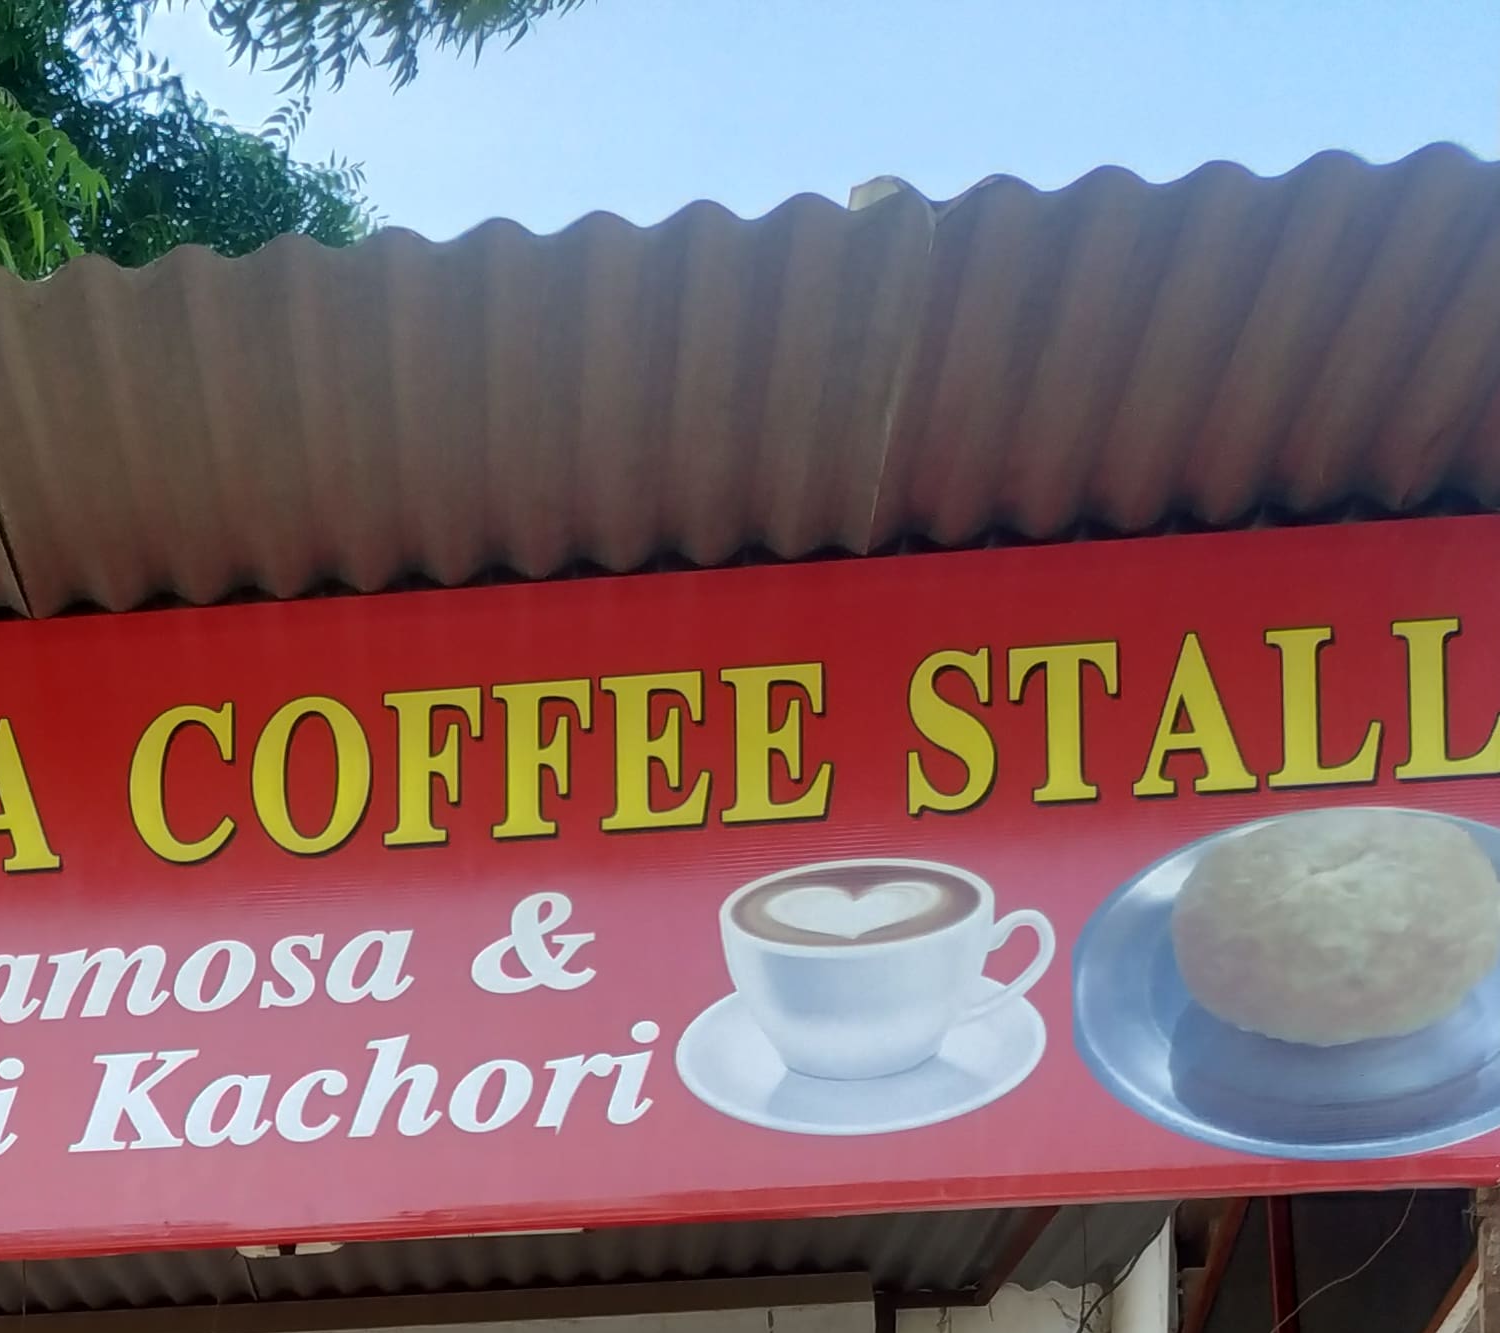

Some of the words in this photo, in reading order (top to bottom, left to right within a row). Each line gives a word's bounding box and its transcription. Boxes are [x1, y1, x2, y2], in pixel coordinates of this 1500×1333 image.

[128, 660, 835, 866] COFFEE
[906, 617, 1500, 815] STALL
[471, 890, 597, 997] &
[69, 1020, 660, 1157] Kachori
